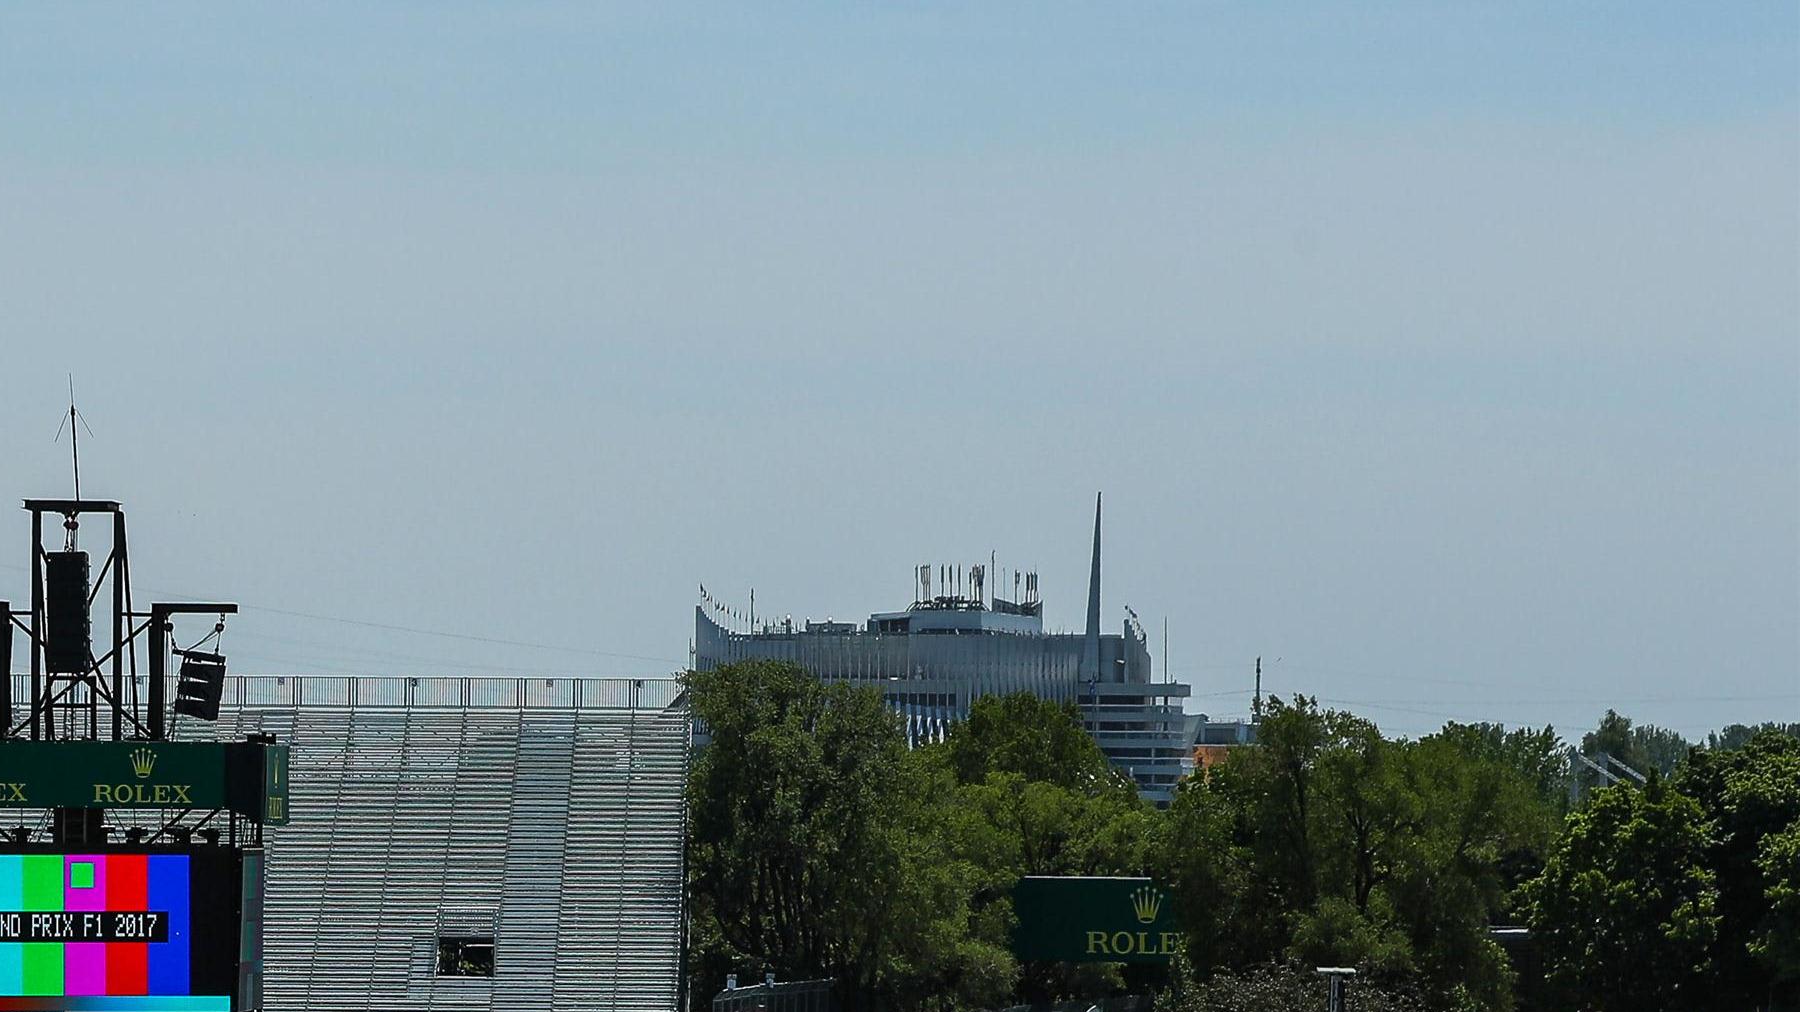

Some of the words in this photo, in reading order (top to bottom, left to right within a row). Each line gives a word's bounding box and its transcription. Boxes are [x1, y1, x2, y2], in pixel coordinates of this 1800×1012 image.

[93, 784, 193, 804] ROLEX
[31, 913, 73, 938] PRIX
[83, 913, 103, 938] F1
[115, 913, 158, 938] 2017
[1086, 931, 1182, 955] ROLE
